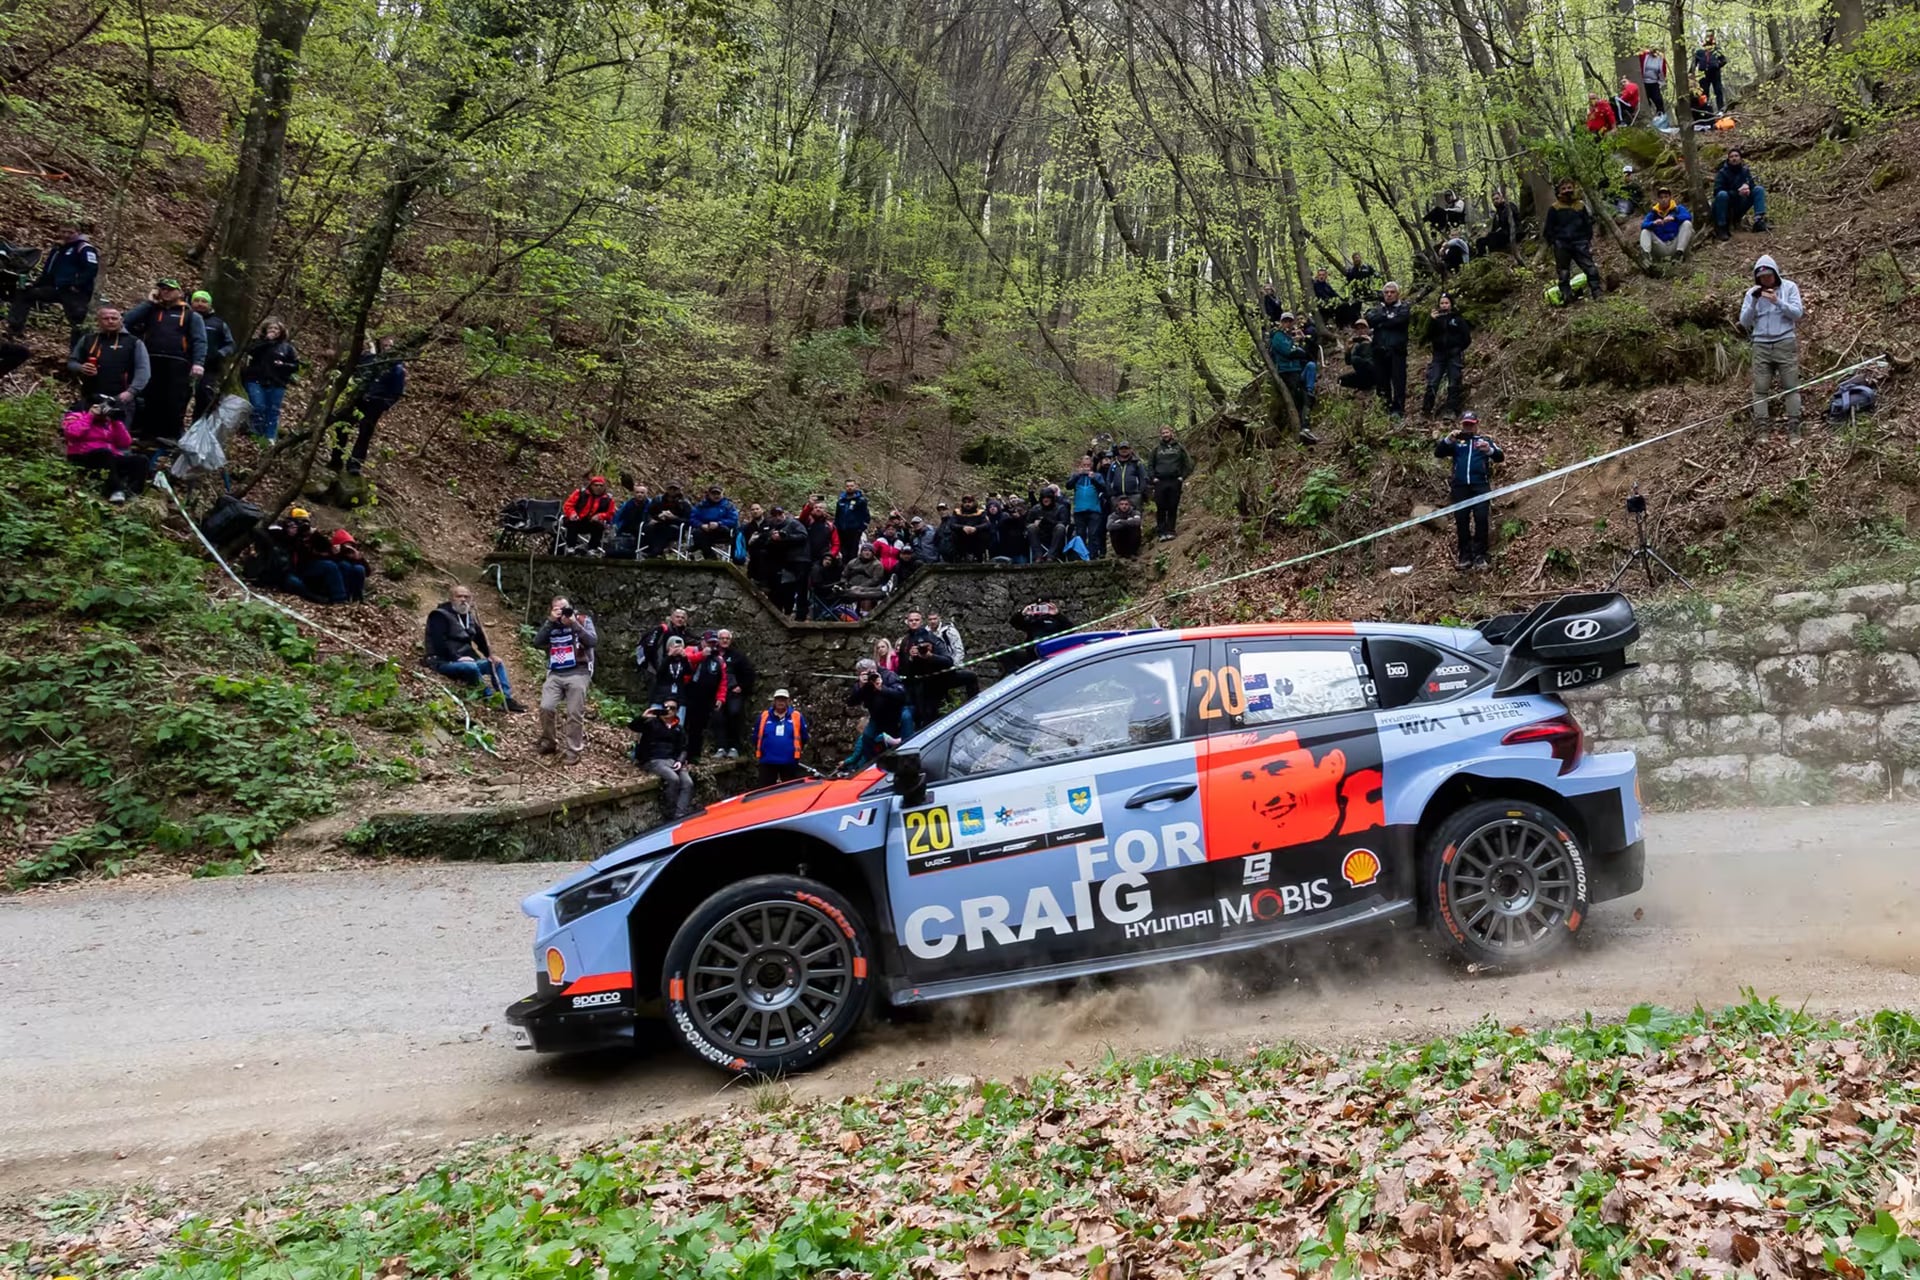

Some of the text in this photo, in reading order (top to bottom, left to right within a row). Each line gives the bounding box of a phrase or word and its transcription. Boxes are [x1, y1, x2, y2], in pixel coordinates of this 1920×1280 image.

[1386, 662, 1406, 676] ixo
[1435, 665, 1470, 676] sparco
[1193, 665, 1246, 720] 20
[1482, 701, 1531, 714] HYUNDAI
[1487, 709, 1524, 721] STEEL
[1381, 714, 1421, 724] HYUNDAI
[906, 807, 950, 854] 20
[1076, 821, 1208, 882] FOR
[924, 856, 951, 868] WRC
[1125, 877, 1333, 939] HYUNDAI MOBIS
[904, 872, 1154, 960] CRAIG
[571, 991, 622, 1008] sparco
